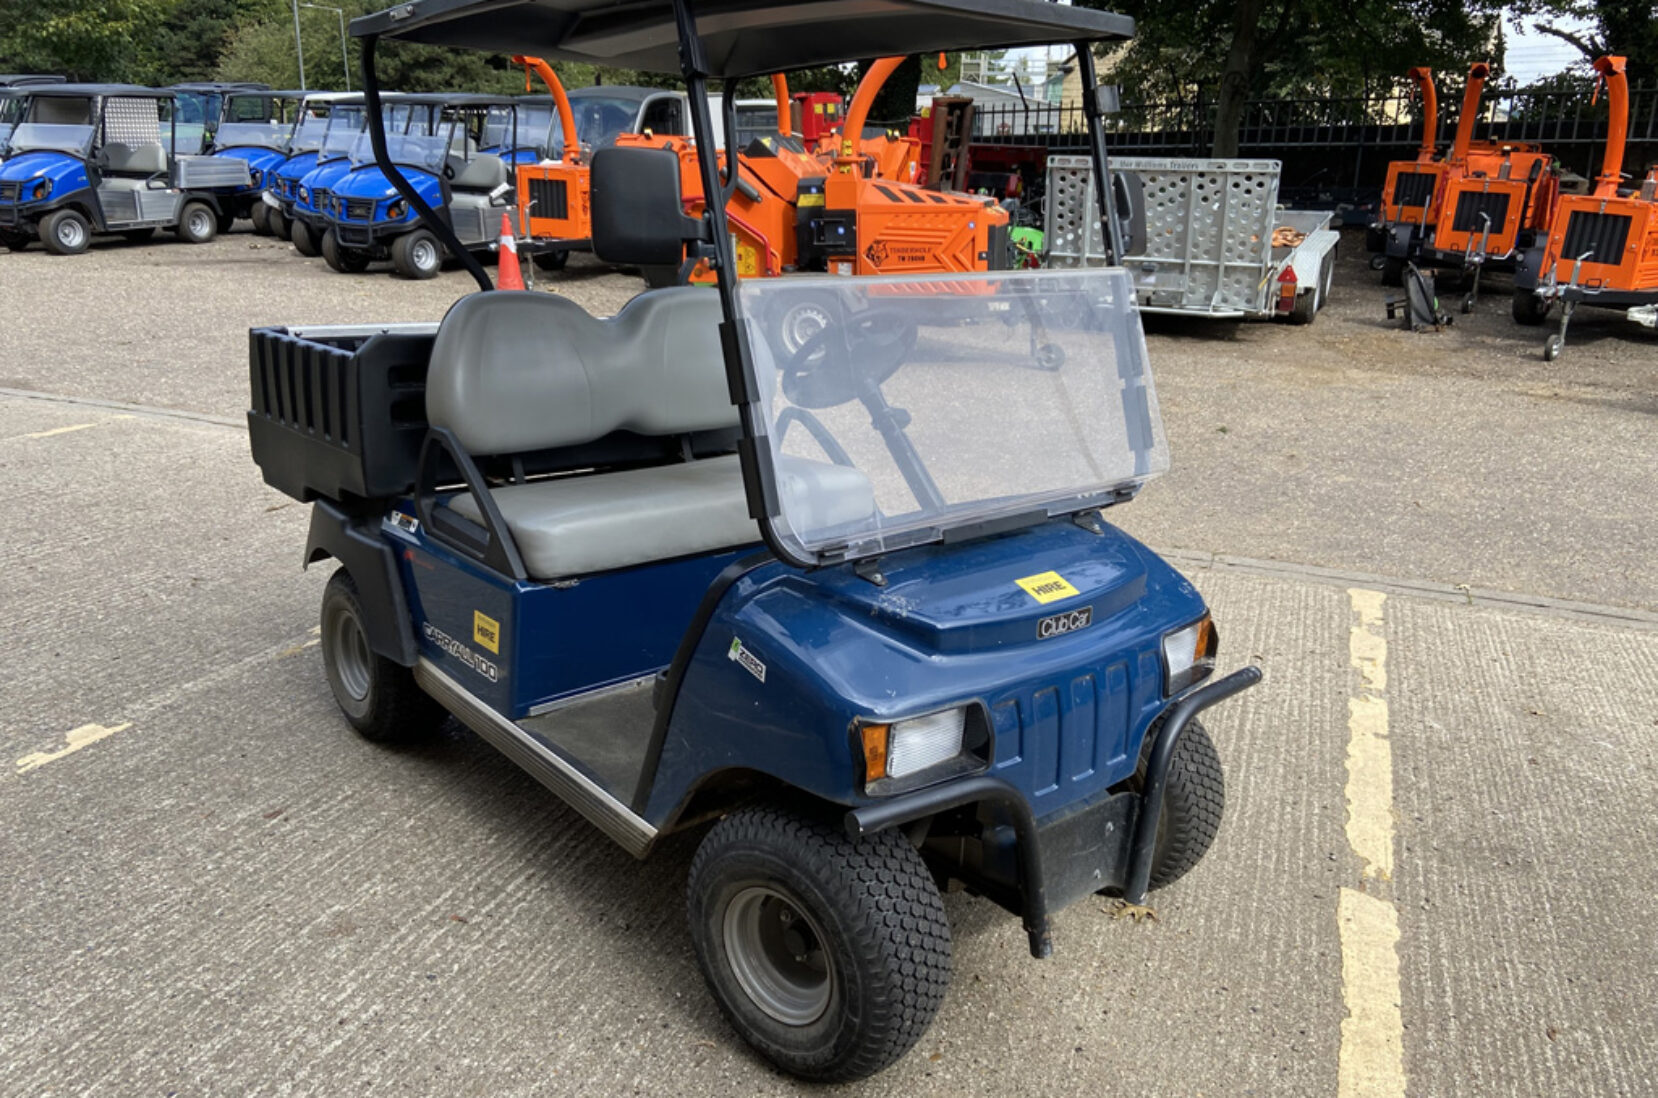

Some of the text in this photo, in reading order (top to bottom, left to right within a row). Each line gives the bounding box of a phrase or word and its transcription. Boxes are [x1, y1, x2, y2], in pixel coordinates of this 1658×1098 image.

[1031, 581, 1067, 595] HIRE
[477, 622, 496, 644] HIRE
[1042, 611, 1088, 636] Club Car
[423, 621, 475, 669] CARRYALL
[475, 652, 498, 683] 100
